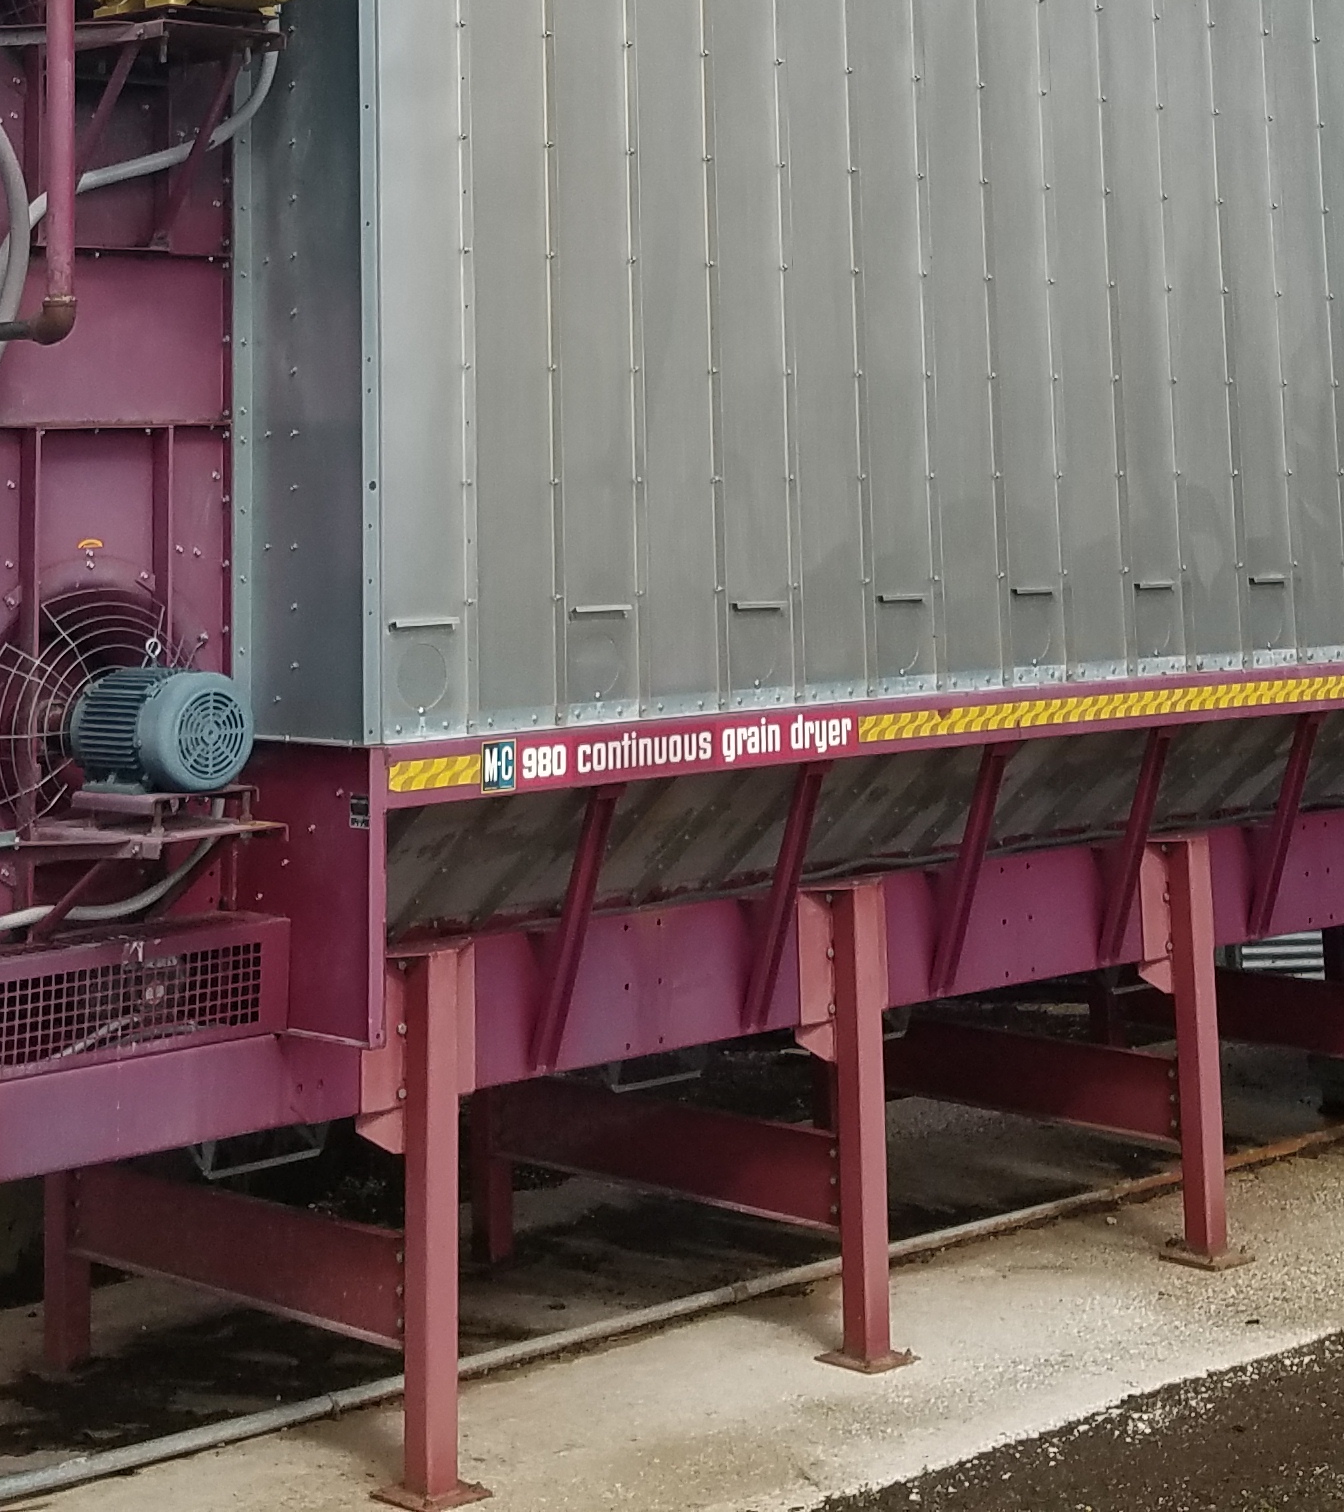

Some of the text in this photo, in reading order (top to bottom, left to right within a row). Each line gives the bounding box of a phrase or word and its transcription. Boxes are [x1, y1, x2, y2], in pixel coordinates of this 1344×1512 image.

[484, 714, 852, 783] M-C 980 continuous grain dryer
